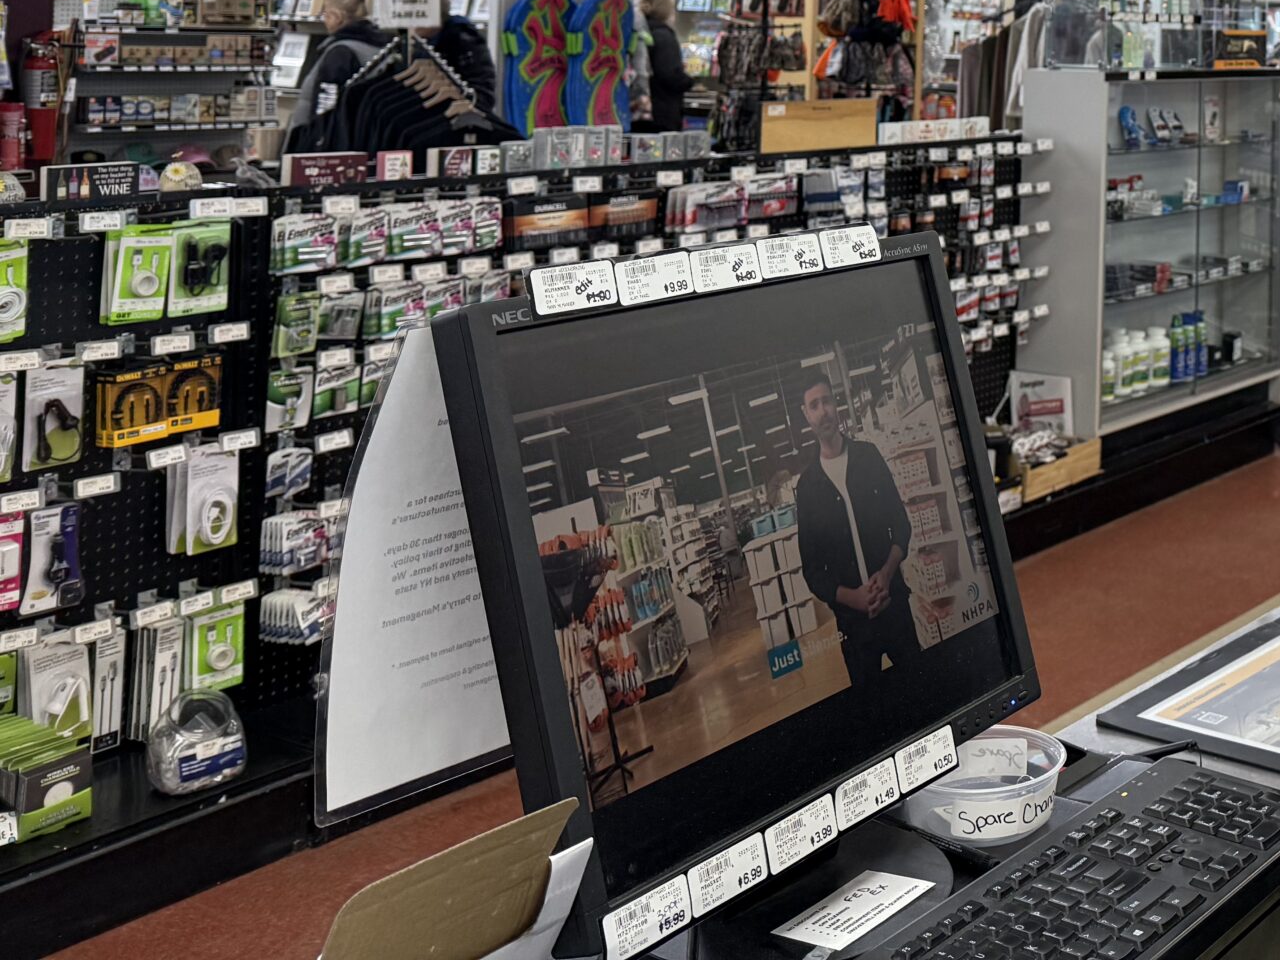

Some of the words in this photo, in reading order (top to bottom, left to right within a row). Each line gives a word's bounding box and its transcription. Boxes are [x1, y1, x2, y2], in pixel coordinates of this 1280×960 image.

[98, 183, 131, 196] WINE
[309, 176, 333, 185] TIME
[441, 208, 472, 224] nergizer
[534, 202, 567, 214] DURACELL
[393, 210, 438, 229] Energizer
[287, 221, 335, 240] Energizer
[792, 247, 807, 261] edit
[851, 239, 865, 253] edit
[884, 246, 912, 257] AccuSync
[731, 257, 744, 273] edit
[573, 276, 595, 295] edit
[663, 279, 688, 294] $9.99
[384, 288, 423, 307] Energizer
[492, 308, 530, 327] NEC
[116, 371, 142, 383] DEWALT
[962, 599, 993, 623] NHPA
[772, 648, 801, 673] Just
[933, 752, 953, 772] $0.50
[874, 785, 894, 806] $1.49
[958, 810, 1018, 835] Spare
[809, 823, 832, 847] $3.99
[737, 864, 762, 888] $6.99
[844, 887, 881, 902] FED
[869, 884, 889, 896] EX
[657, 908, 686, 934] $5.99
